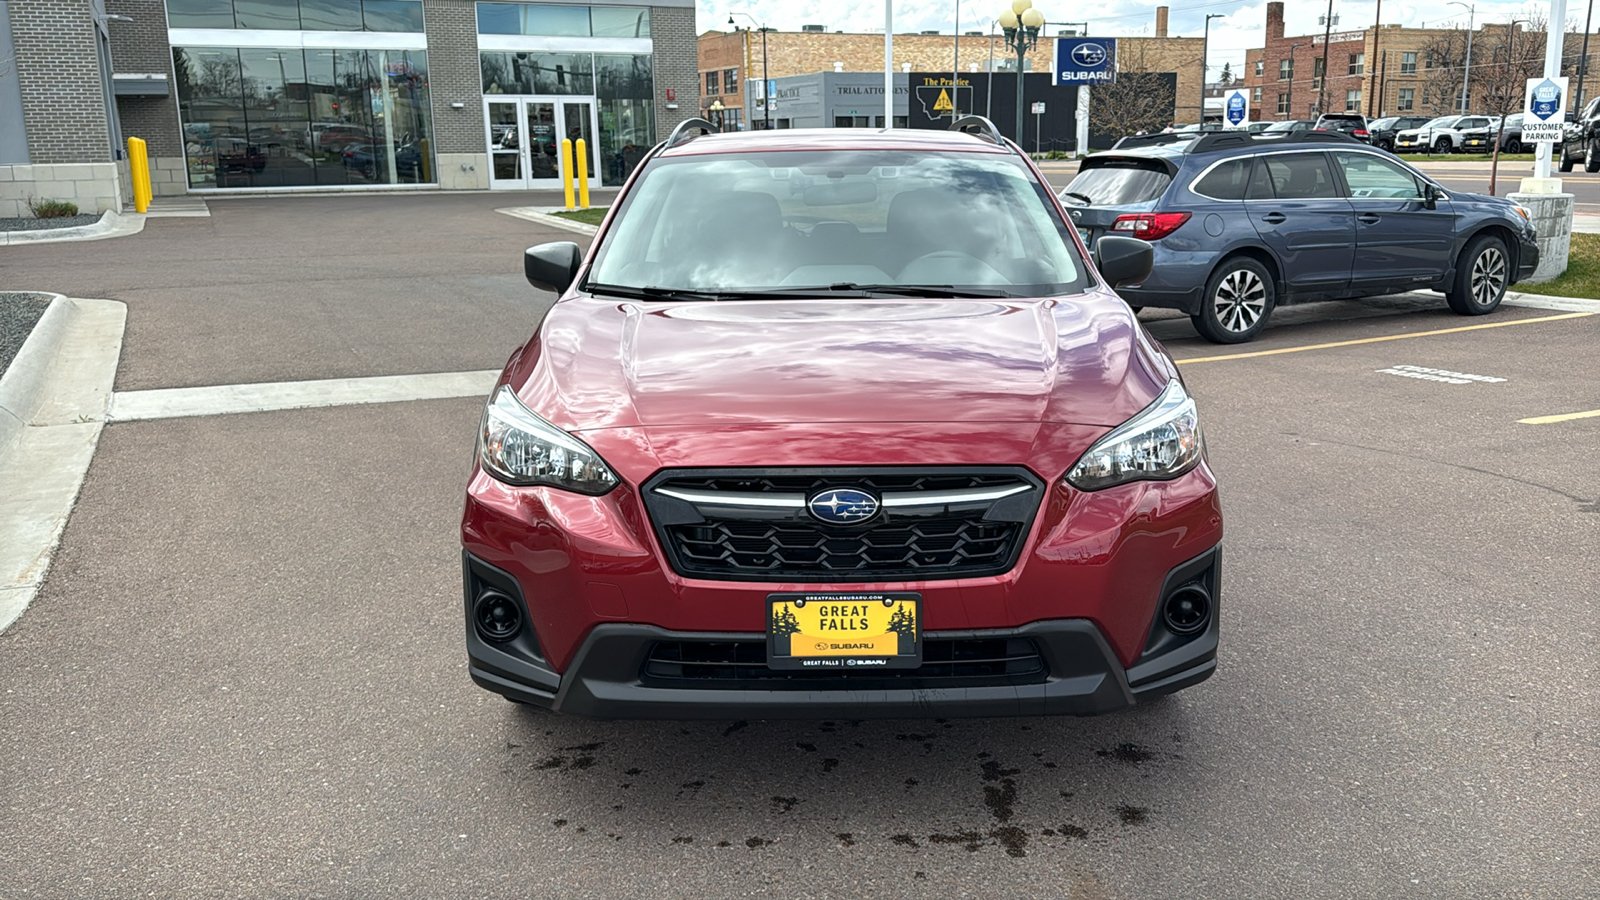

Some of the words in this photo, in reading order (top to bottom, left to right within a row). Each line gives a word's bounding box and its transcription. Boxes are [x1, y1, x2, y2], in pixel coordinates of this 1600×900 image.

[1062, 71, 1112, 80] SUBARU
[923, 77, 938, 86] The
[837, 87, 862, 95] TRIAL
[864, 87, 909, 95] ATTOEYS
[1522, 123, 1563, 131] CUSTOMER
[1525, 132, 1559, 140] PARKING
[819, 605, 869, 617] GREAT
[819, 618, 869, 630] FALLS
